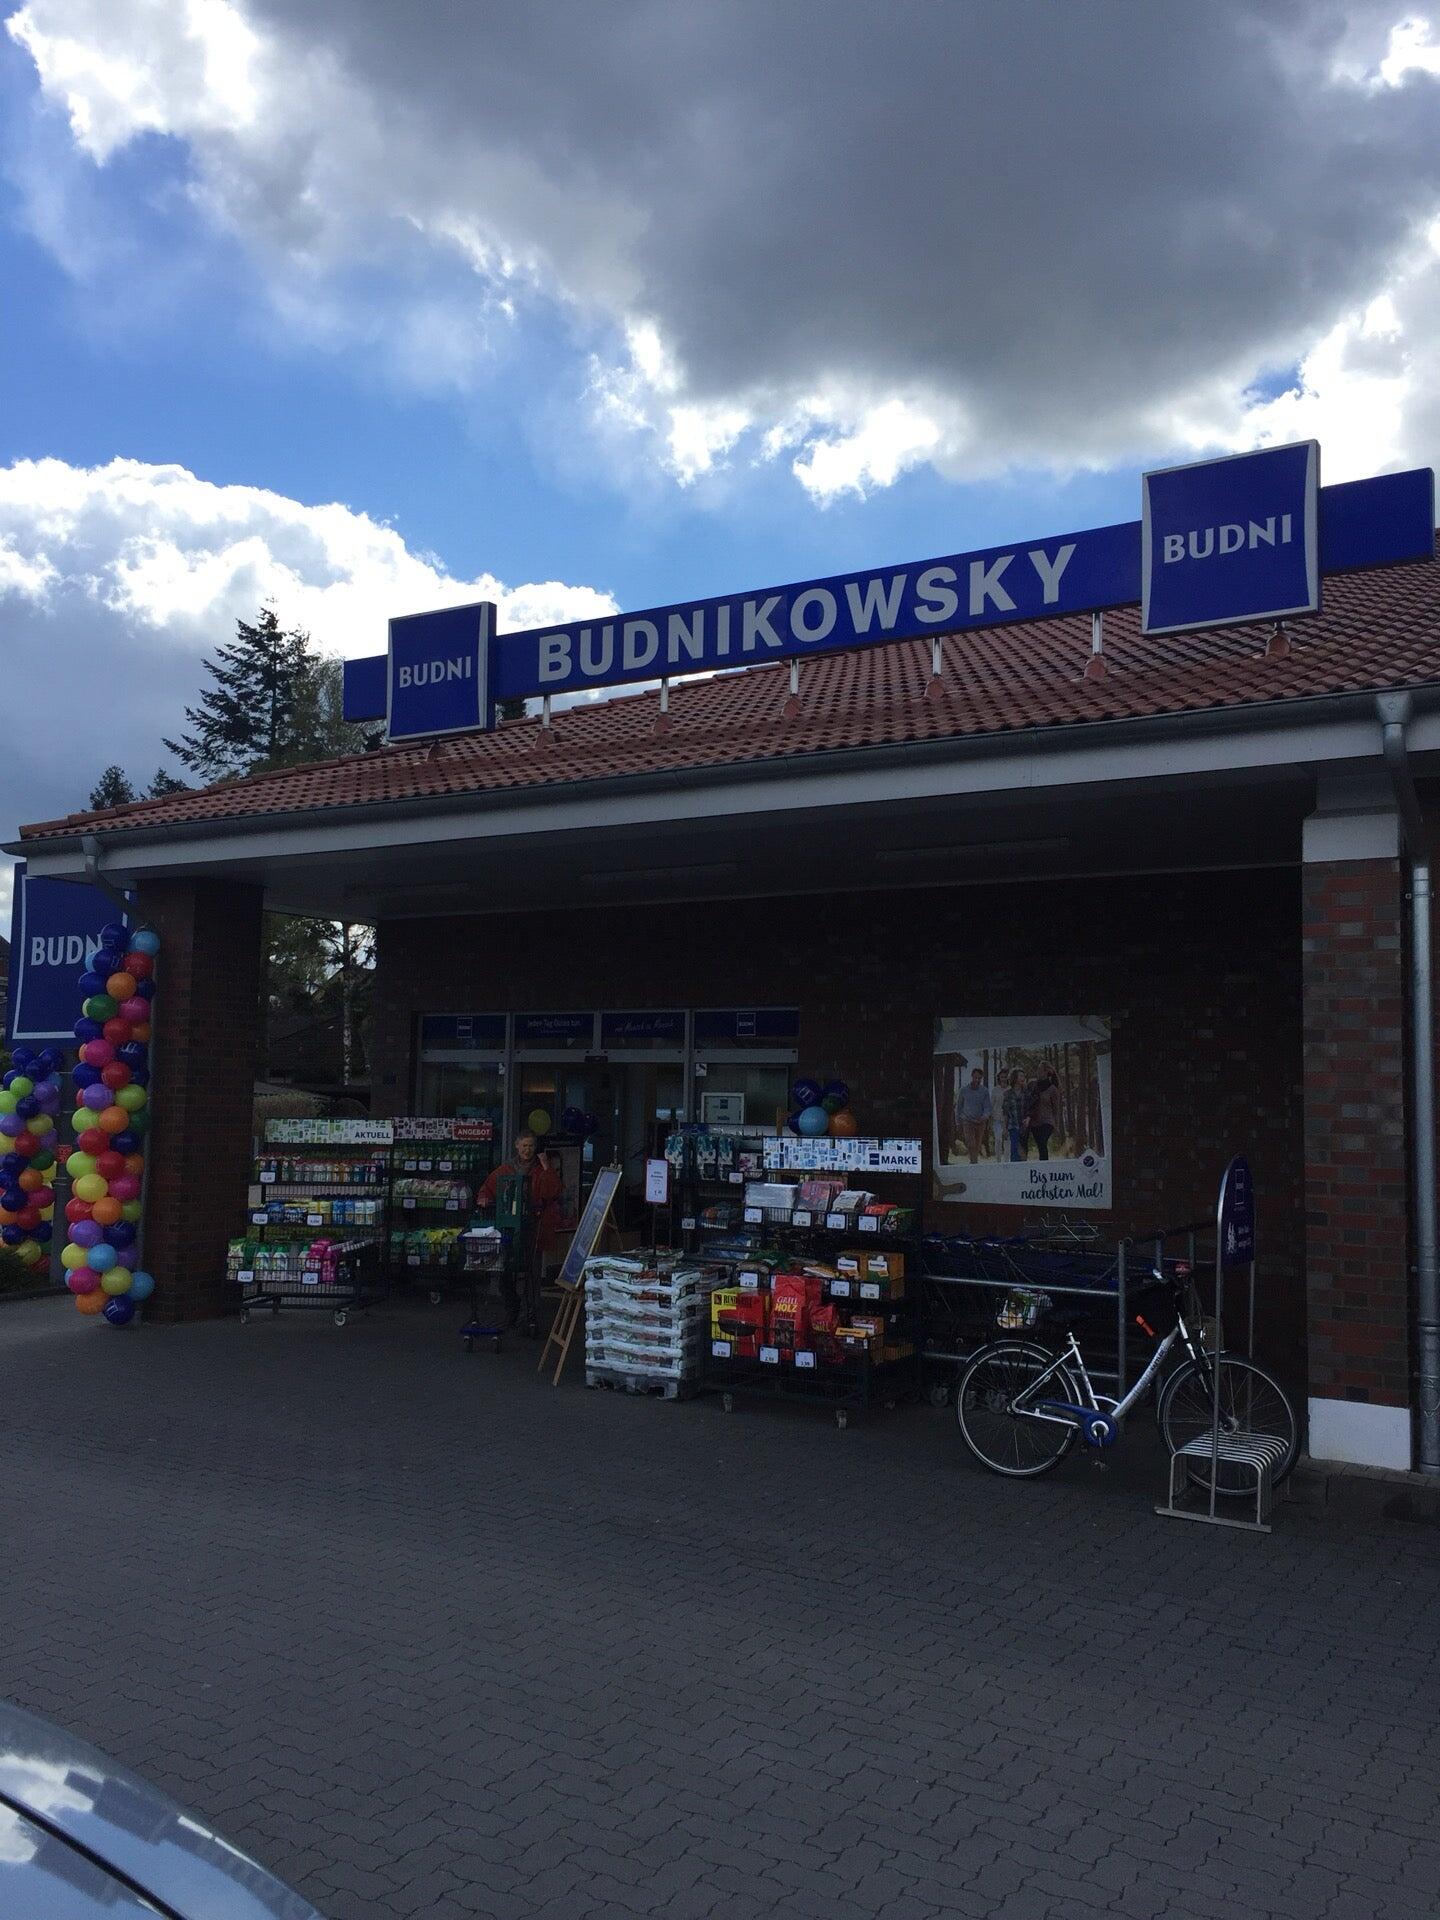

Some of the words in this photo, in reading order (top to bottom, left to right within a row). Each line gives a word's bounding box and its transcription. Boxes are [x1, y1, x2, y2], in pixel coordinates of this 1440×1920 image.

[1163, 513, 1292, 564] BUDNI
[537, 543, 1077, 683] BUDNIKOWSKY
[399, 656, 472, 689] BUDNI
[30, 933, 103, 966] BUDN
[354, 1131, 391, 1140] AKTUELL
[456, 1128, 491, 1137] ANGEBOT
[881, 1155, 918, 1165] MARKE
[1030, 1169, 1047, 1184] Bis
[1049, 1172, 1075, 1181] zum
[1075, 1182, 1103, 1198] Mal!
[775, 1303, 798, 1313] HOLZ
